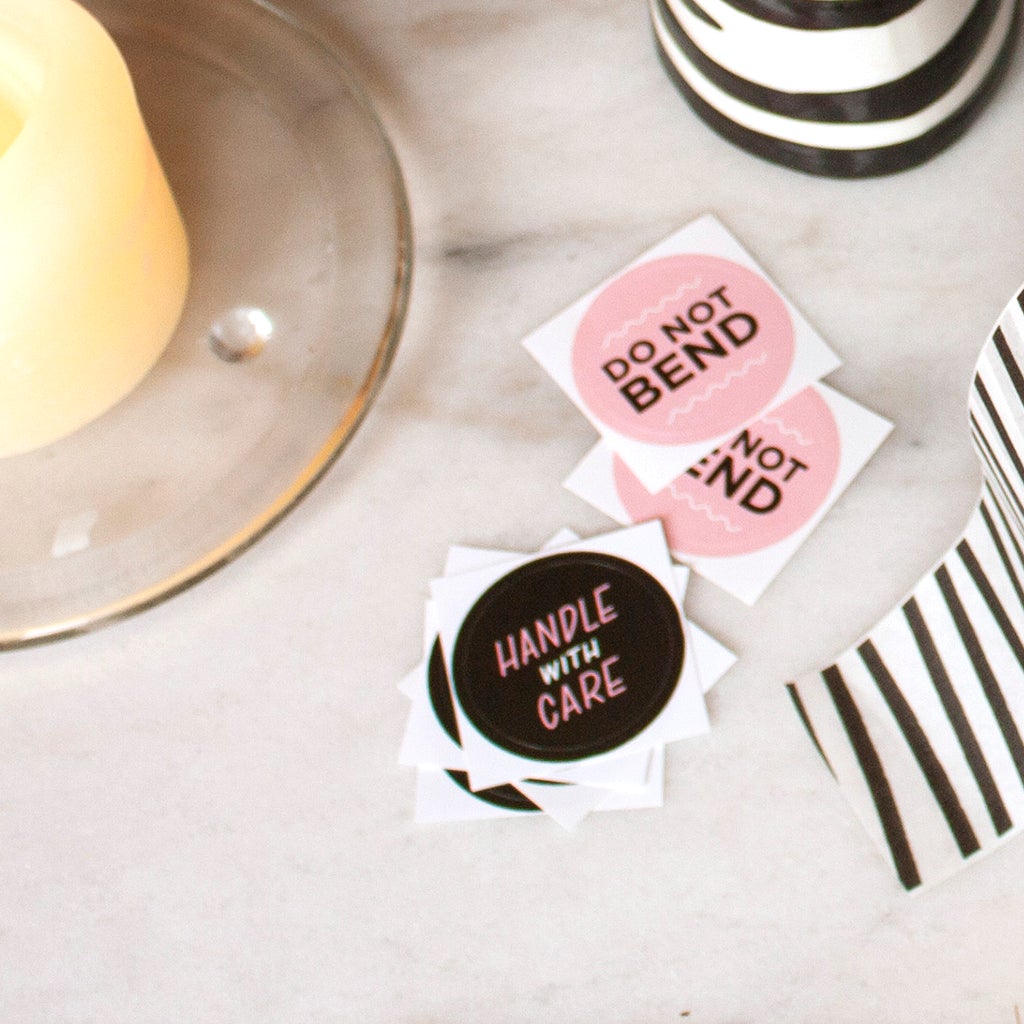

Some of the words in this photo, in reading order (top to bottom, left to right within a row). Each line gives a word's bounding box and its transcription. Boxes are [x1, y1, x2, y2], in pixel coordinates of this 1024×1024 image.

[602, 340, 656, 384] DO
[659, 285, 732, 343] NOT
[619, 312, 759, 414] BEND
[730, 429, 808, 482] NOT
[494, 582, 619, 677] HANDLE
[539, 637, 601, 686] WITH
[537, 655, 628, 730] CARE
